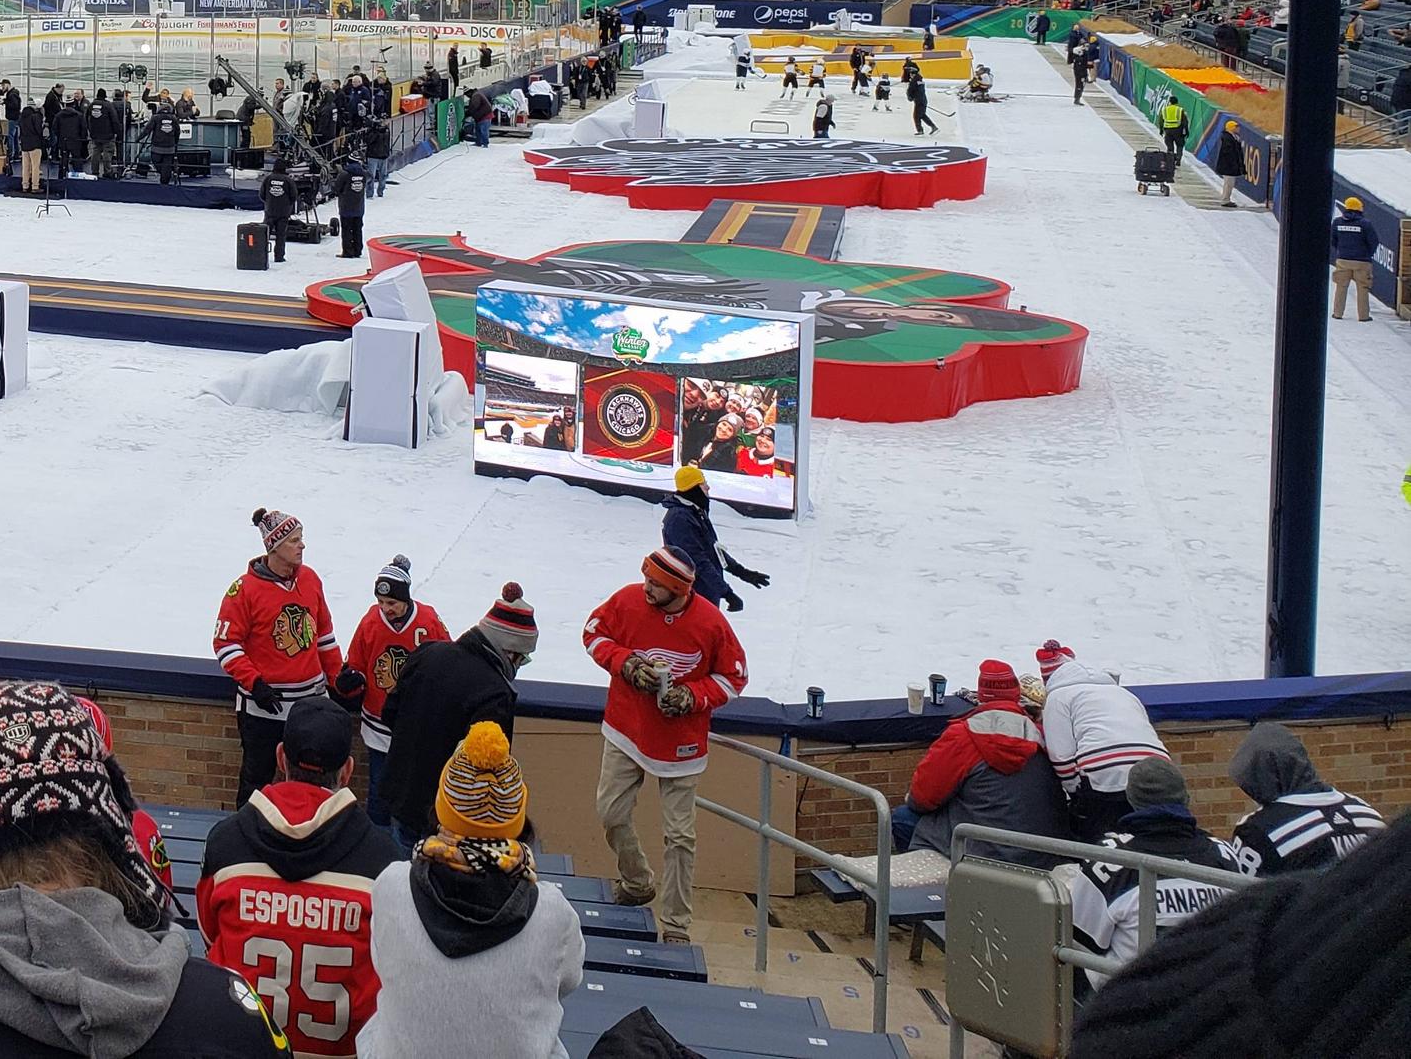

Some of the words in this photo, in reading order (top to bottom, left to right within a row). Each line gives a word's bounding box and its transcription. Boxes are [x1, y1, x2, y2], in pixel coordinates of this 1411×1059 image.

[216, 0, 249, 9] AMSTERDAM
[774, 8, 808, 23] pepsi
[42, 20, 85, 31] GEICO
[333, 22, 399, 34] BRIDGESTONE
[608, 395, 643, 419] BLACKHAWKS
[611, 420, 640, 434] CHICAGO
[414, 628, 428, 647] C
[239, 888, 362, 932] ESPOSITO
[243, 936, 353, 1042] 35
